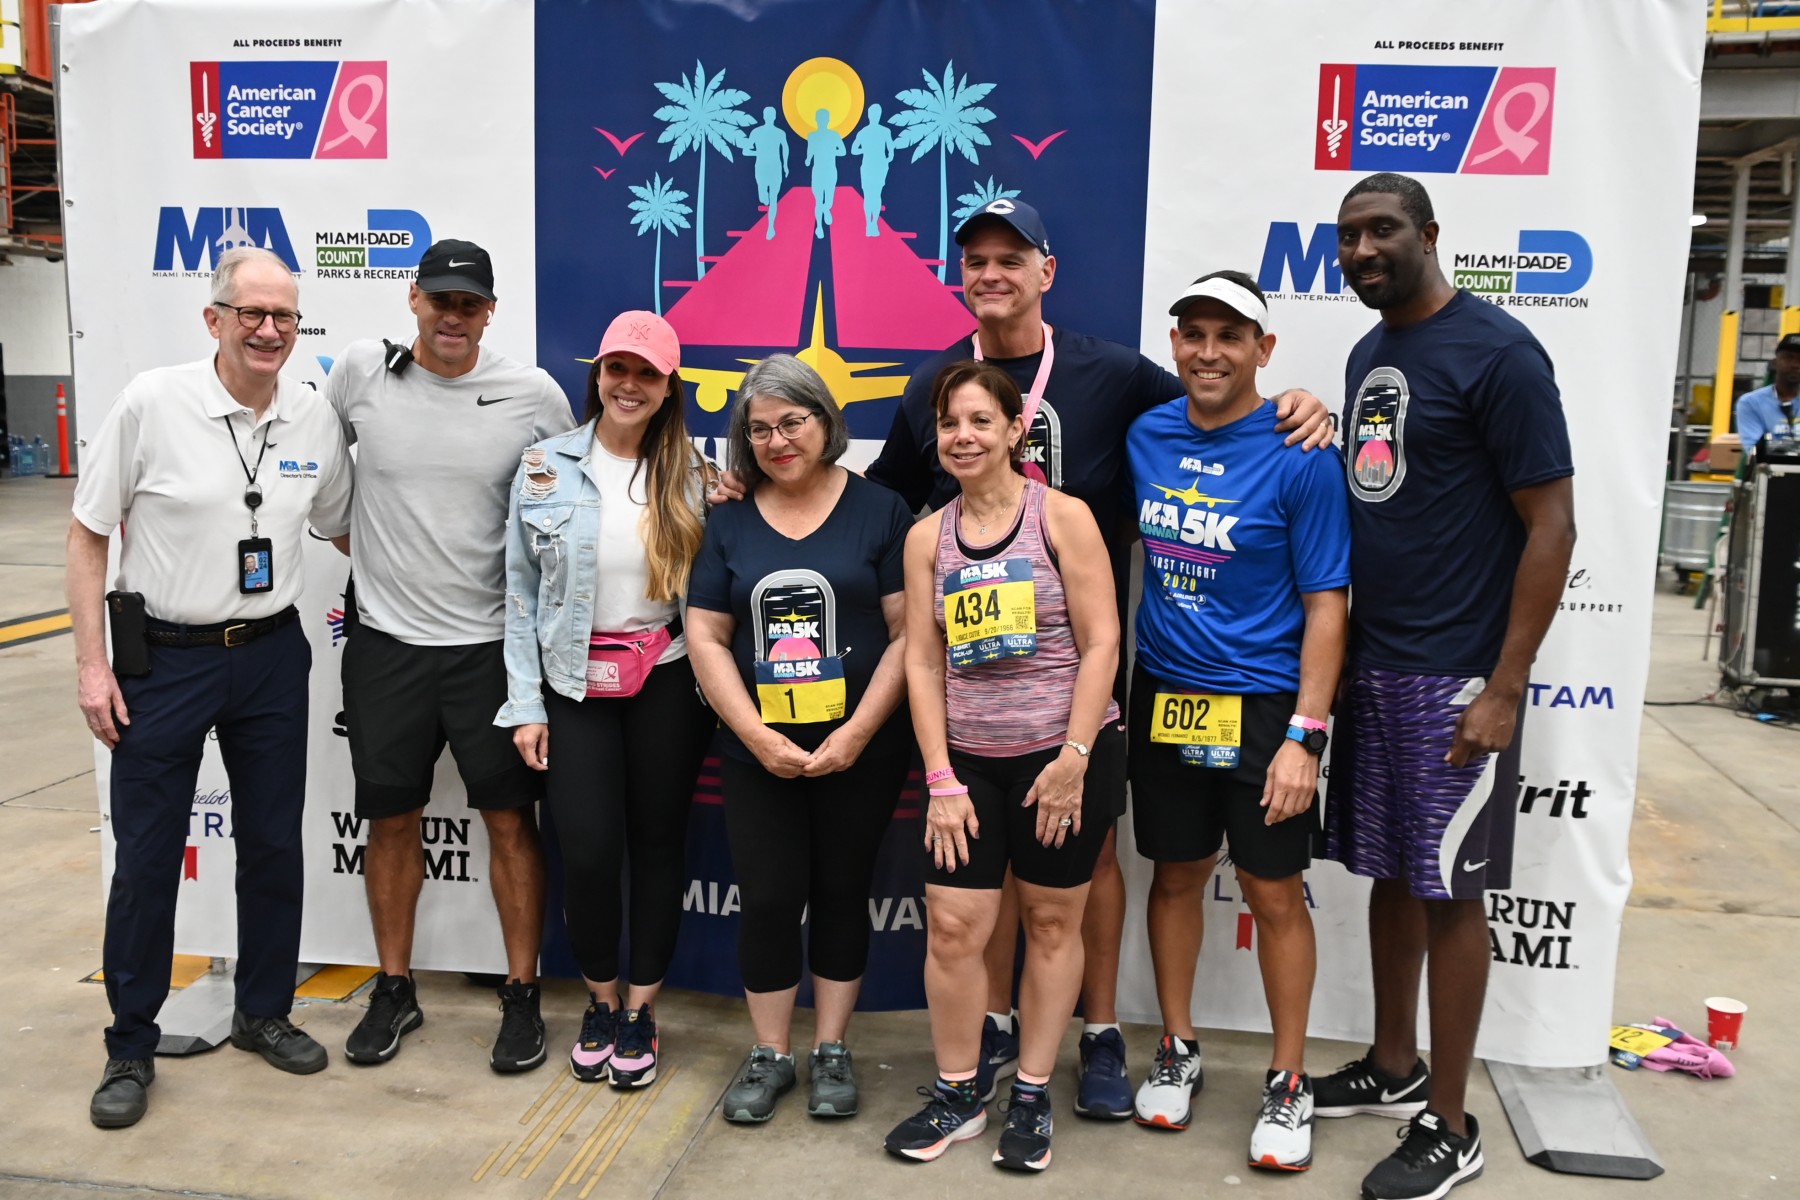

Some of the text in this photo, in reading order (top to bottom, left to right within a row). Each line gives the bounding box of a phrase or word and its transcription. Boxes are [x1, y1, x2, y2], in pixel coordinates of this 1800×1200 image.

[233, 39, 342, 47] ALL PROCEEDS BENEFIT
[1374, 41, 1504, 51] ALL PROCEEDS BENEFIT
[227, 85, 316, 101] American
[1362, 90, 1469, 110] American
[227, 103, 291, 118] Cancer
[1361, 109, 1438, 129] Cancer
[317, 250, 364, 264] COUNTY
[317, 269, 419, 279] PARKS & RECREATI
[1454, 274, 1511, 290] COUNTY
[1291, 294, 1362, 303] INTERNATIO
[1496, 295, 1505, 305] &
[1508, 296, 1588, 308] RECREATION
[1180, 561, 1216, 580] FLIGHT
[1163, 572, 1197, 592] 2020
[954, 589, 1001, 628] 434
[1560, 602, 1623, 613] SUPPORT
[979, 641, 1000, 651] ULTRA
[1007, 638, 1033, 646] ULTRA
[784, 688, 796, 719] 1
[1528, 683, 1614, 709] TAM
[1162, 697, 1210, 730] 602
[1182, 748, 1205, 757] ULTRA
[1211, 750, 1236, 758] ULTRA
[193, 788, 230, 805] helob
[421, 816, 471, 845] UN
[1488, 892, 1576, 930] RUN
[1489, 927, 1572, 969] AMI
